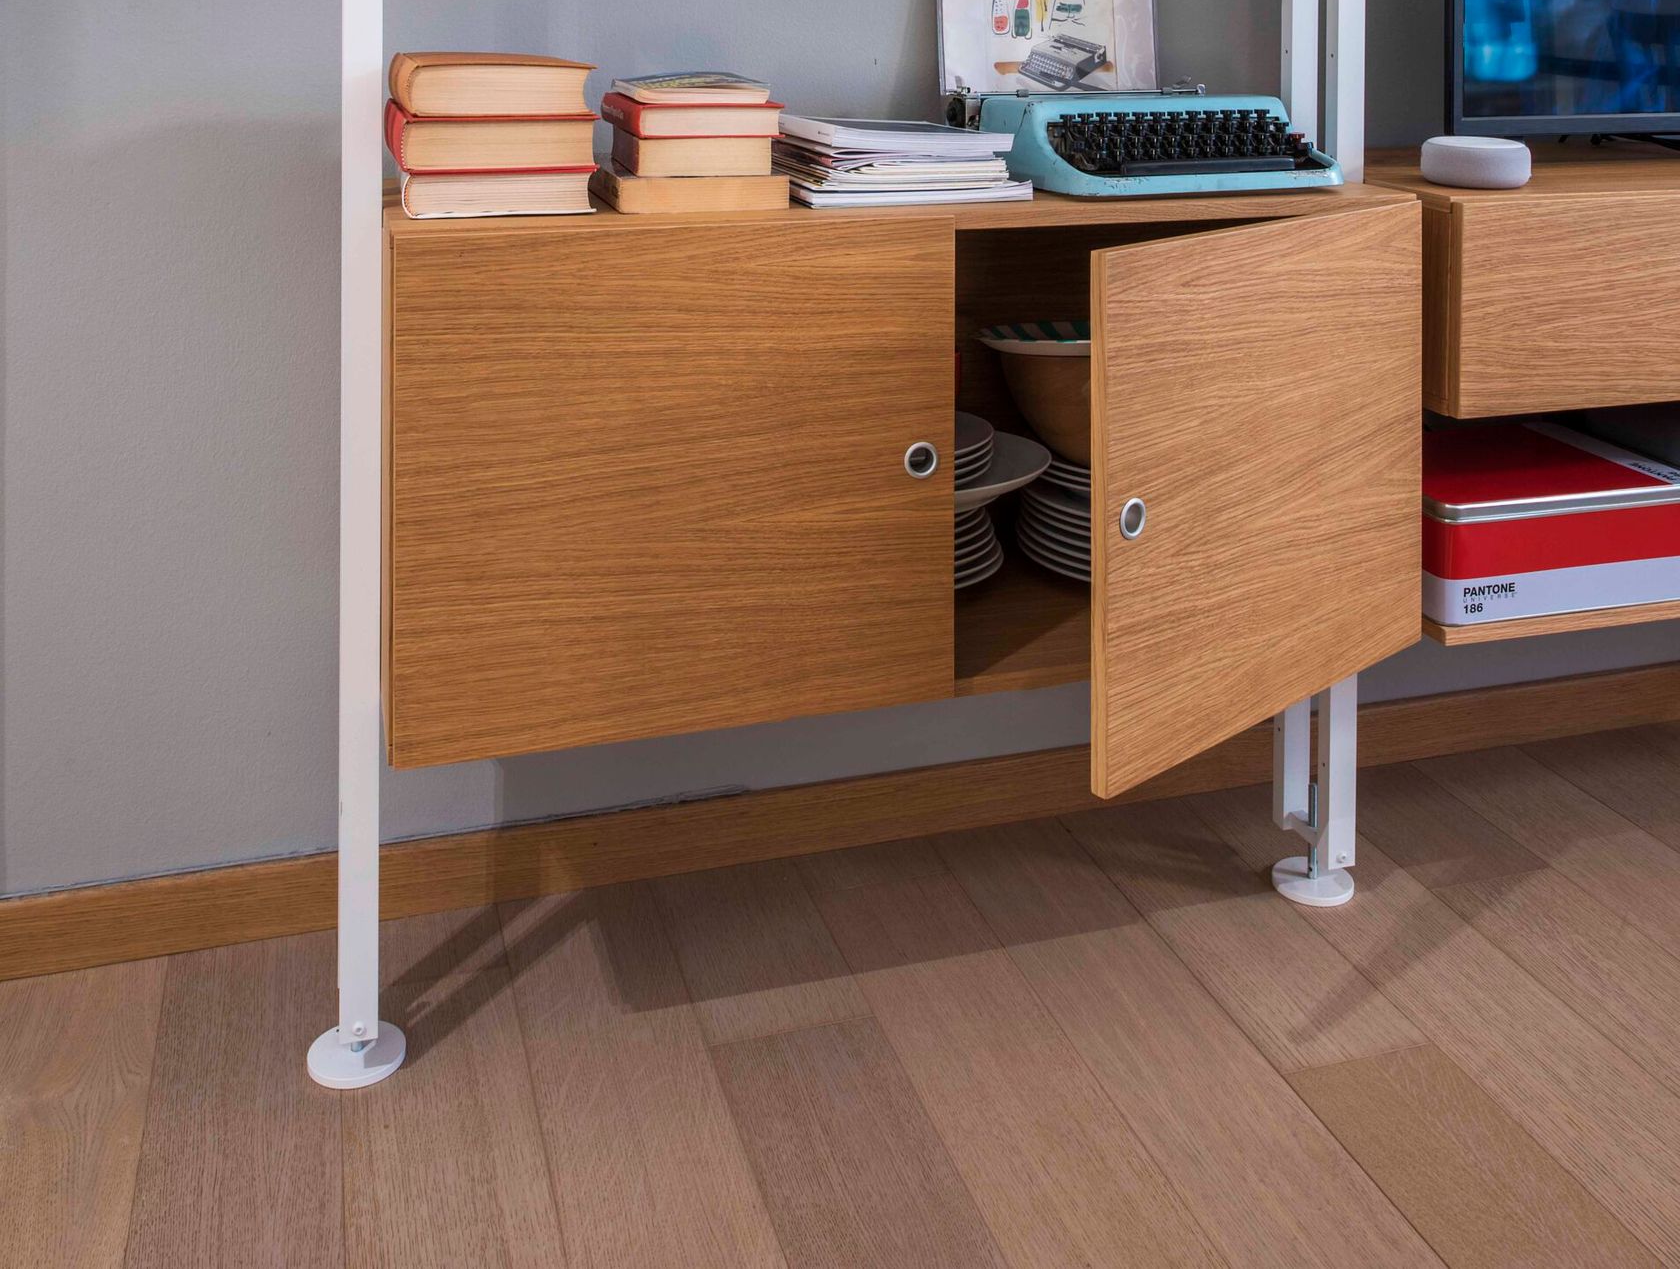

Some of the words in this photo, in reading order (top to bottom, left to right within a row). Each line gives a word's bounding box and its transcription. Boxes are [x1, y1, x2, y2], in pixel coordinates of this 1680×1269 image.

[1463, 582, 1516, 598] PANTONE
[1463, 591, 1517, 603] UNIVERSE
[1463, 603, 1484, 614] 186
